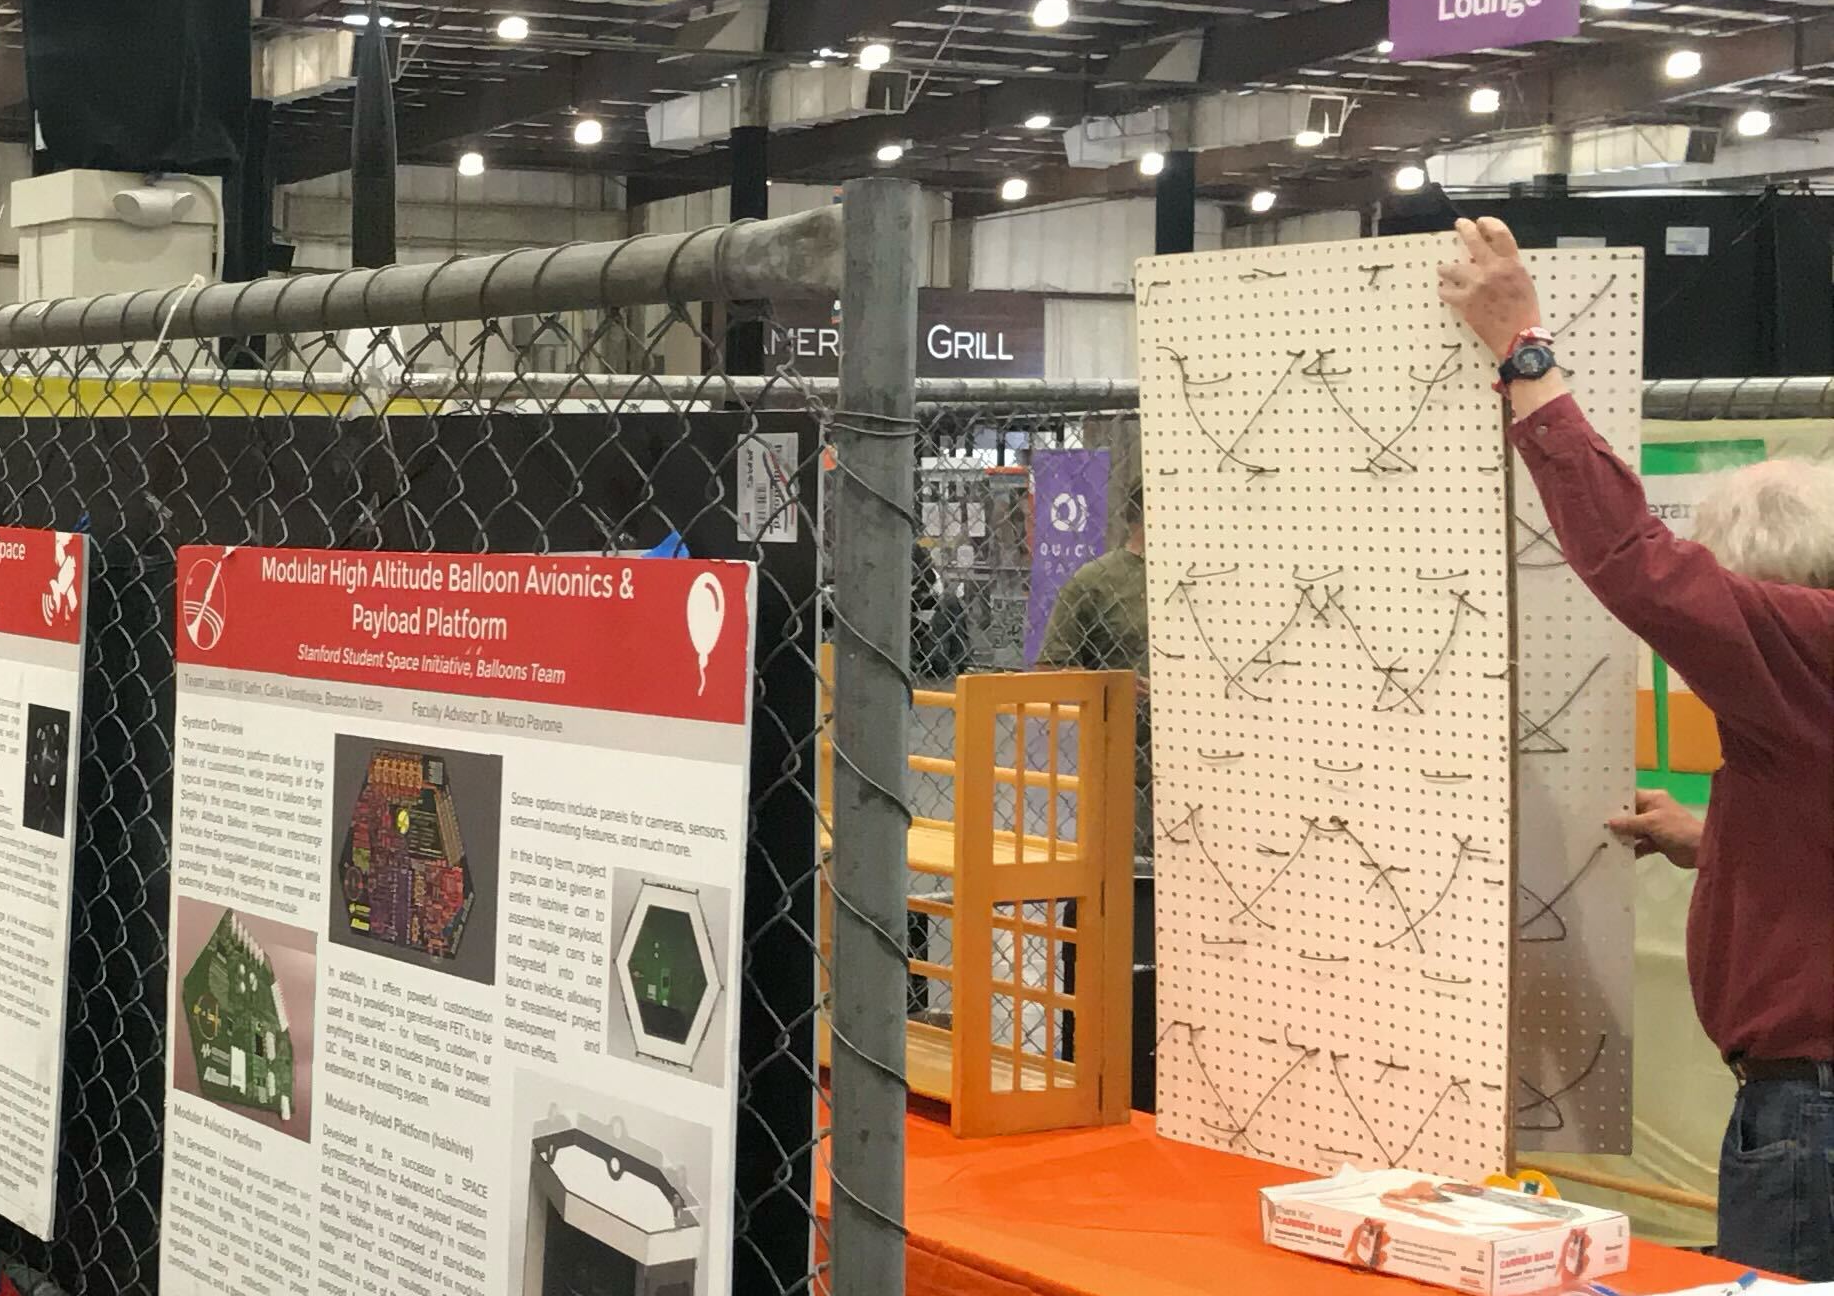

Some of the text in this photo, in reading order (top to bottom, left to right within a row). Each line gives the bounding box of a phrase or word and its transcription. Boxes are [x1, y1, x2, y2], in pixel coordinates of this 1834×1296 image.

[926, 324, 1014, 360] GRILL
[261, 556, 634, 599] Modular High Altitude Balloon Avionics &
[352, 603, 507, 640] Payload Platform
[298, 643, 566, 684] Stanford Student Space Initiative, Balloons Team
[511, 792, 728, 841] Some options include panels for cameras, sensors,
[1318, 1221, 1342, 1237] BAGS
